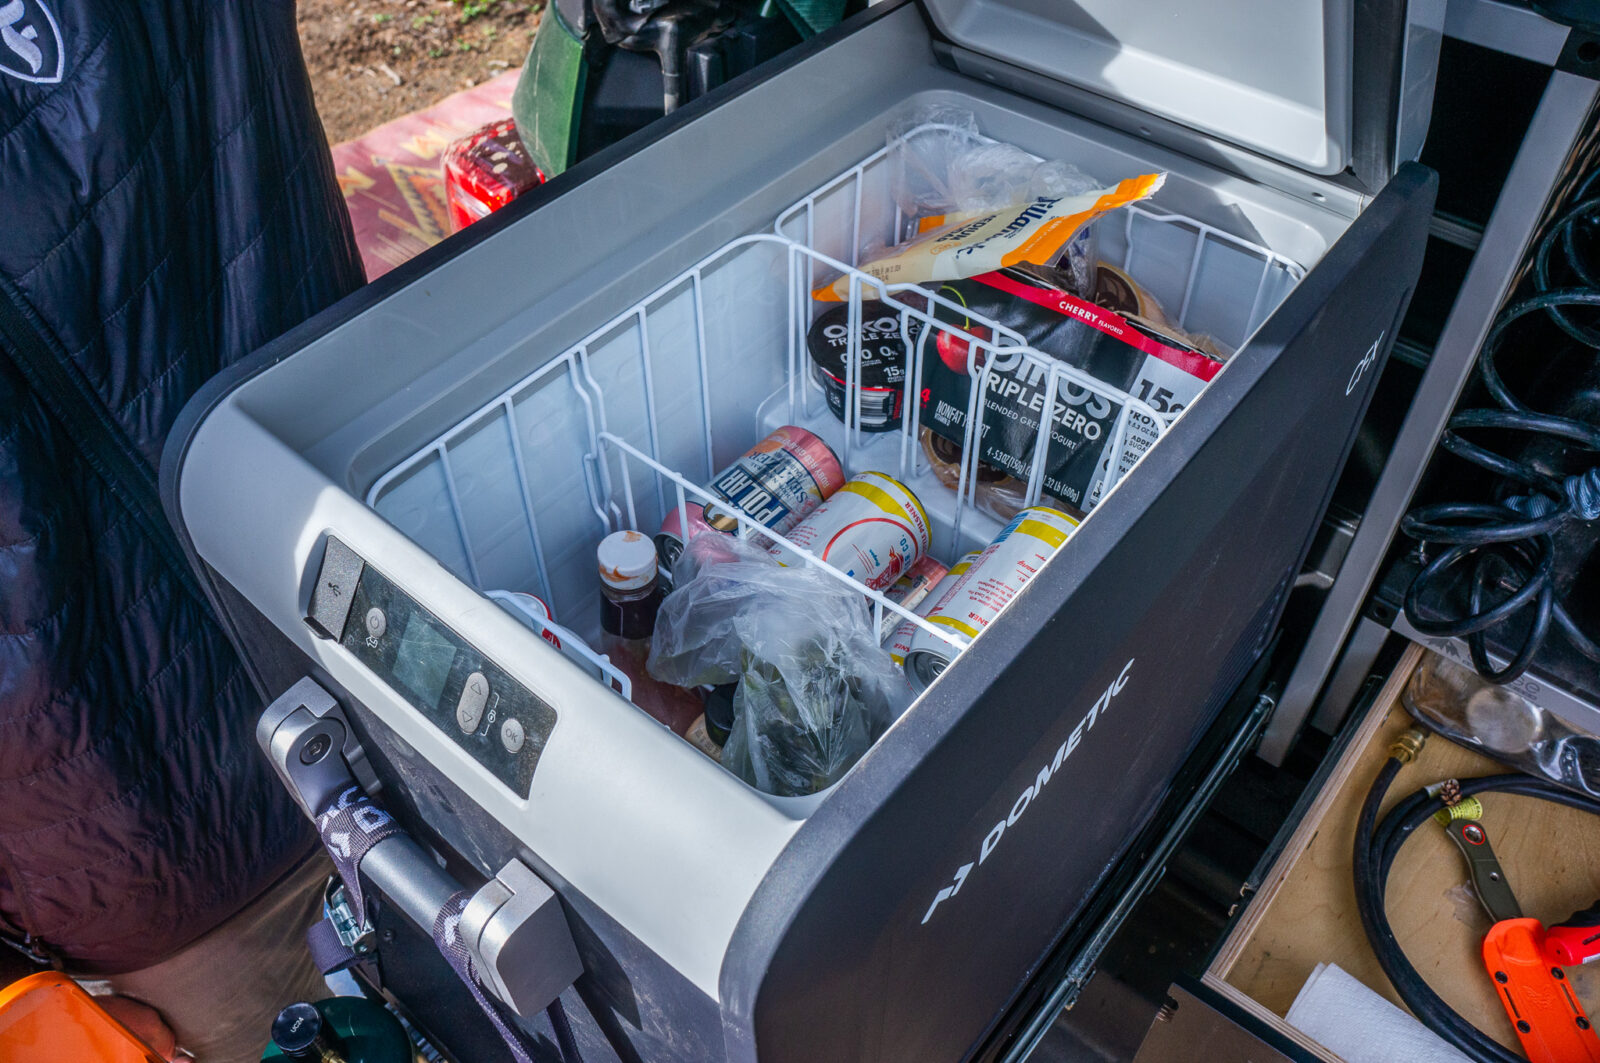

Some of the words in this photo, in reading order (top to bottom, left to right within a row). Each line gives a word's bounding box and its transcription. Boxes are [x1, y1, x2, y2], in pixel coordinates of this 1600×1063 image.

[957, 193, 1063, 258] Tillamk
[823, 313, 919, 339] OKOS
[1058, 300, 1098, 322] CHERRY
[1097, 319, 1123, 335] FLAVORED
[827, 332, 878, 347] TRLE
[936, 400, 964, 425] NONFAT
[1052, 402, 1101, 441] ZERO
[1020, 415, 1041, 431] GREE
[1050, 429, 1077, 450] YOGURT
[1128, 440, 1146, 453] SUGA
[749, 452, 808, 504] SELTZER
[814, 467, 830, 488] RUBY
[719, 469, 785, 525] POLAR
[904, 501, 925, 535] PILSNER
[1017, 560, 1037, 574] pany
[968, 611, 990, 627] SNER
[505, 728, 518, 742] OK
[978, 657, 1135, 866] DOMETIC
